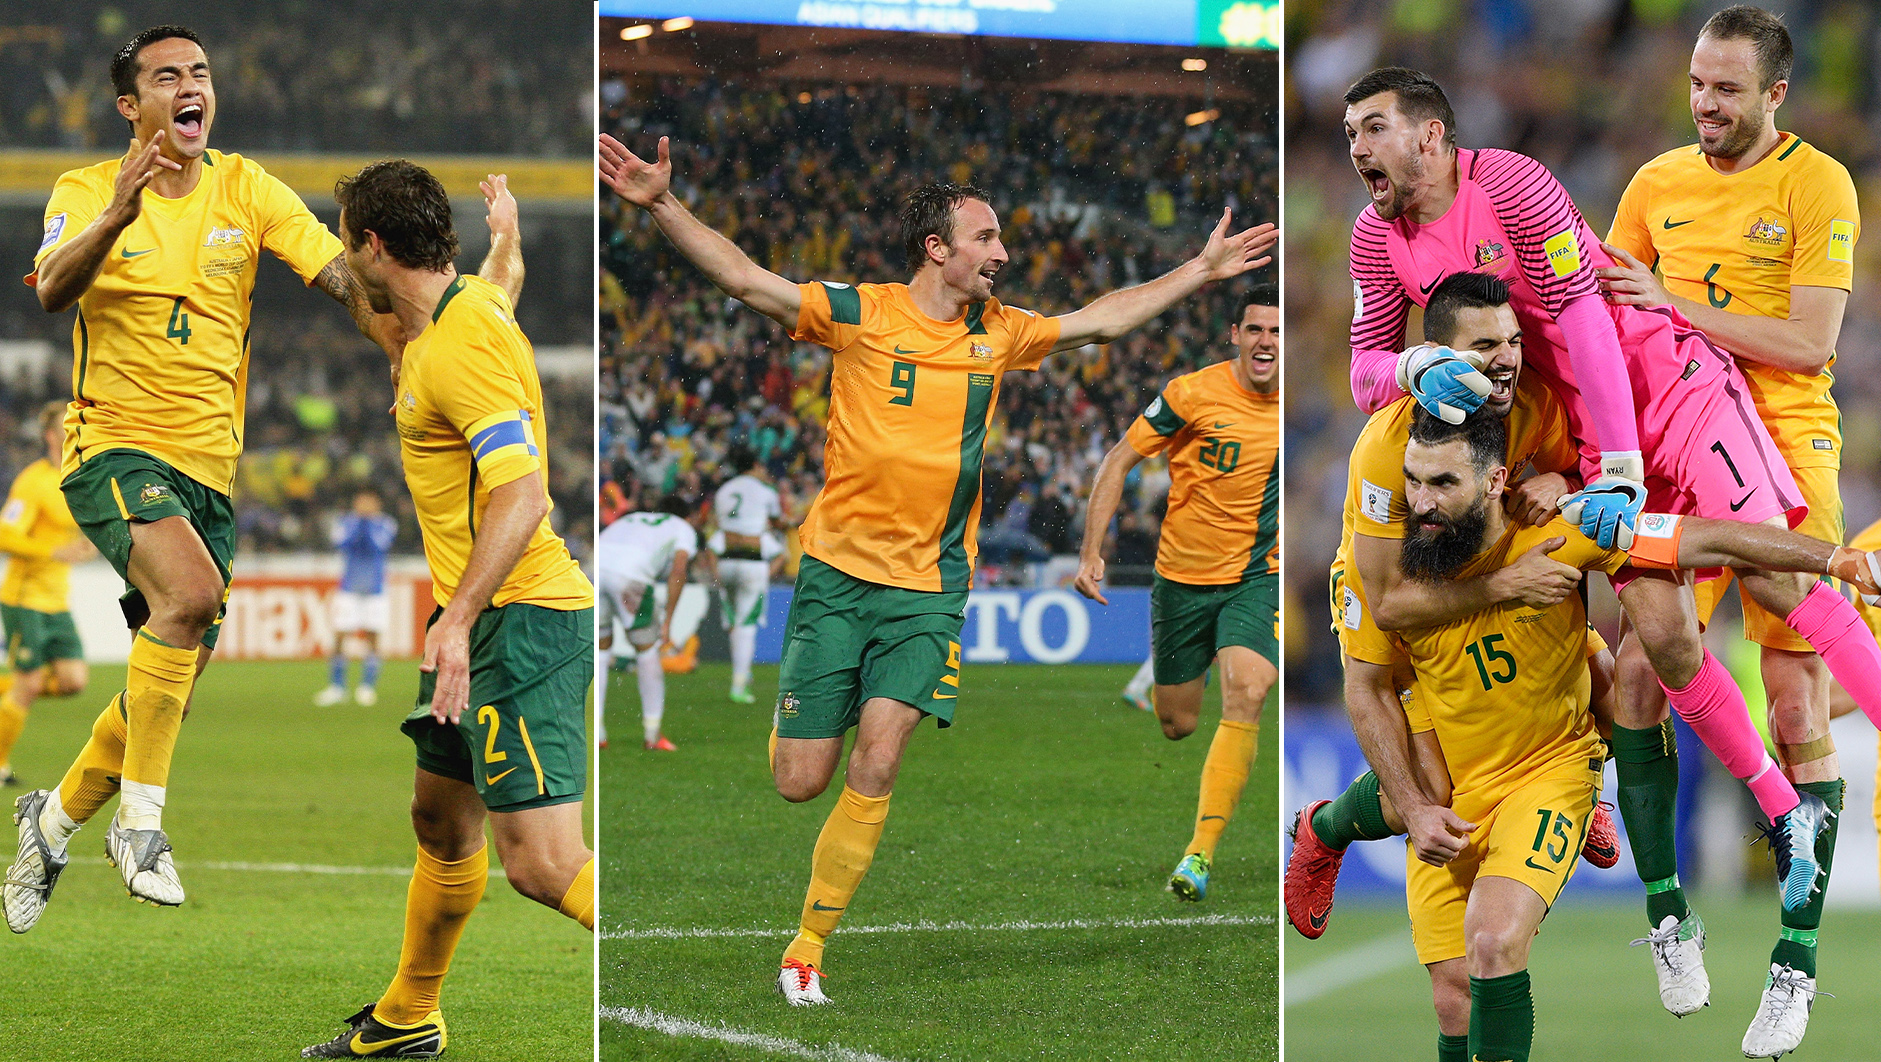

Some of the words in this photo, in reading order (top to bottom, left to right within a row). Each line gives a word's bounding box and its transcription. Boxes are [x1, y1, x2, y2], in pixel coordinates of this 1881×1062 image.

[1550, 247, 1570, 260] FIFA
[1749, 238, 1781, 246] AUSTRALIA
[1833, 233, 1849, 242] FIFA
[1704, 263, 1732, 309] 6
[167, 296, 191, 345] 4
[888, 361, 917, 407] 9
[1199, 437, 1241, 473] 20
[1606, 466, 1624, 475] RYAN
[1710, 440, 1745, 488] 1
[1465, 632, 1517, 691] 15
[477, 705, 507, 764] 2
[1532, 809, 1573, 864] 15
